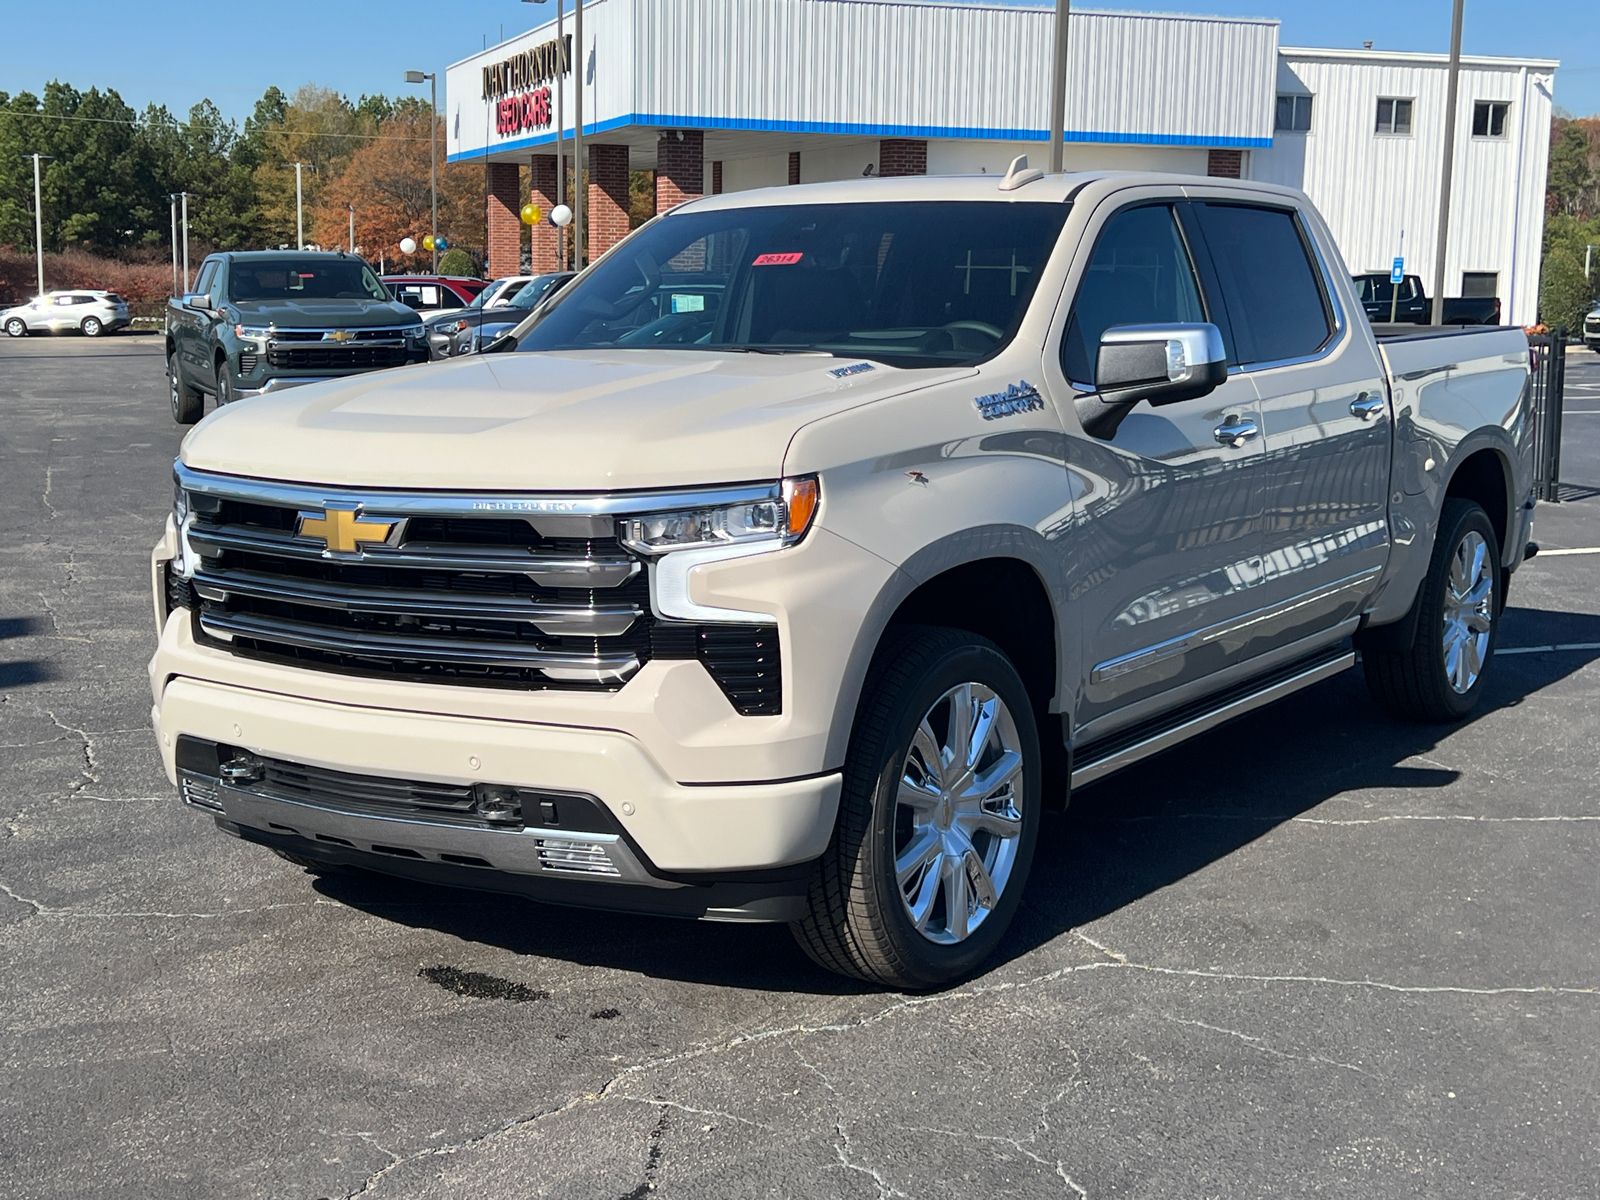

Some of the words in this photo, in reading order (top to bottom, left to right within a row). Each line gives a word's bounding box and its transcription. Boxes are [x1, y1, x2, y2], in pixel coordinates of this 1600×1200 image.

[482, 61, 508, 102] JOHN
[508, 34, 572, 91] THORNTON
[496, 97, 519, 135] USED
[521, 86, 550, 128] CARS
[759, 254, 795, 264] 26314
[473, 502, 506, 510] HIGH
[510, 502, 577, 511] COUNTRY
